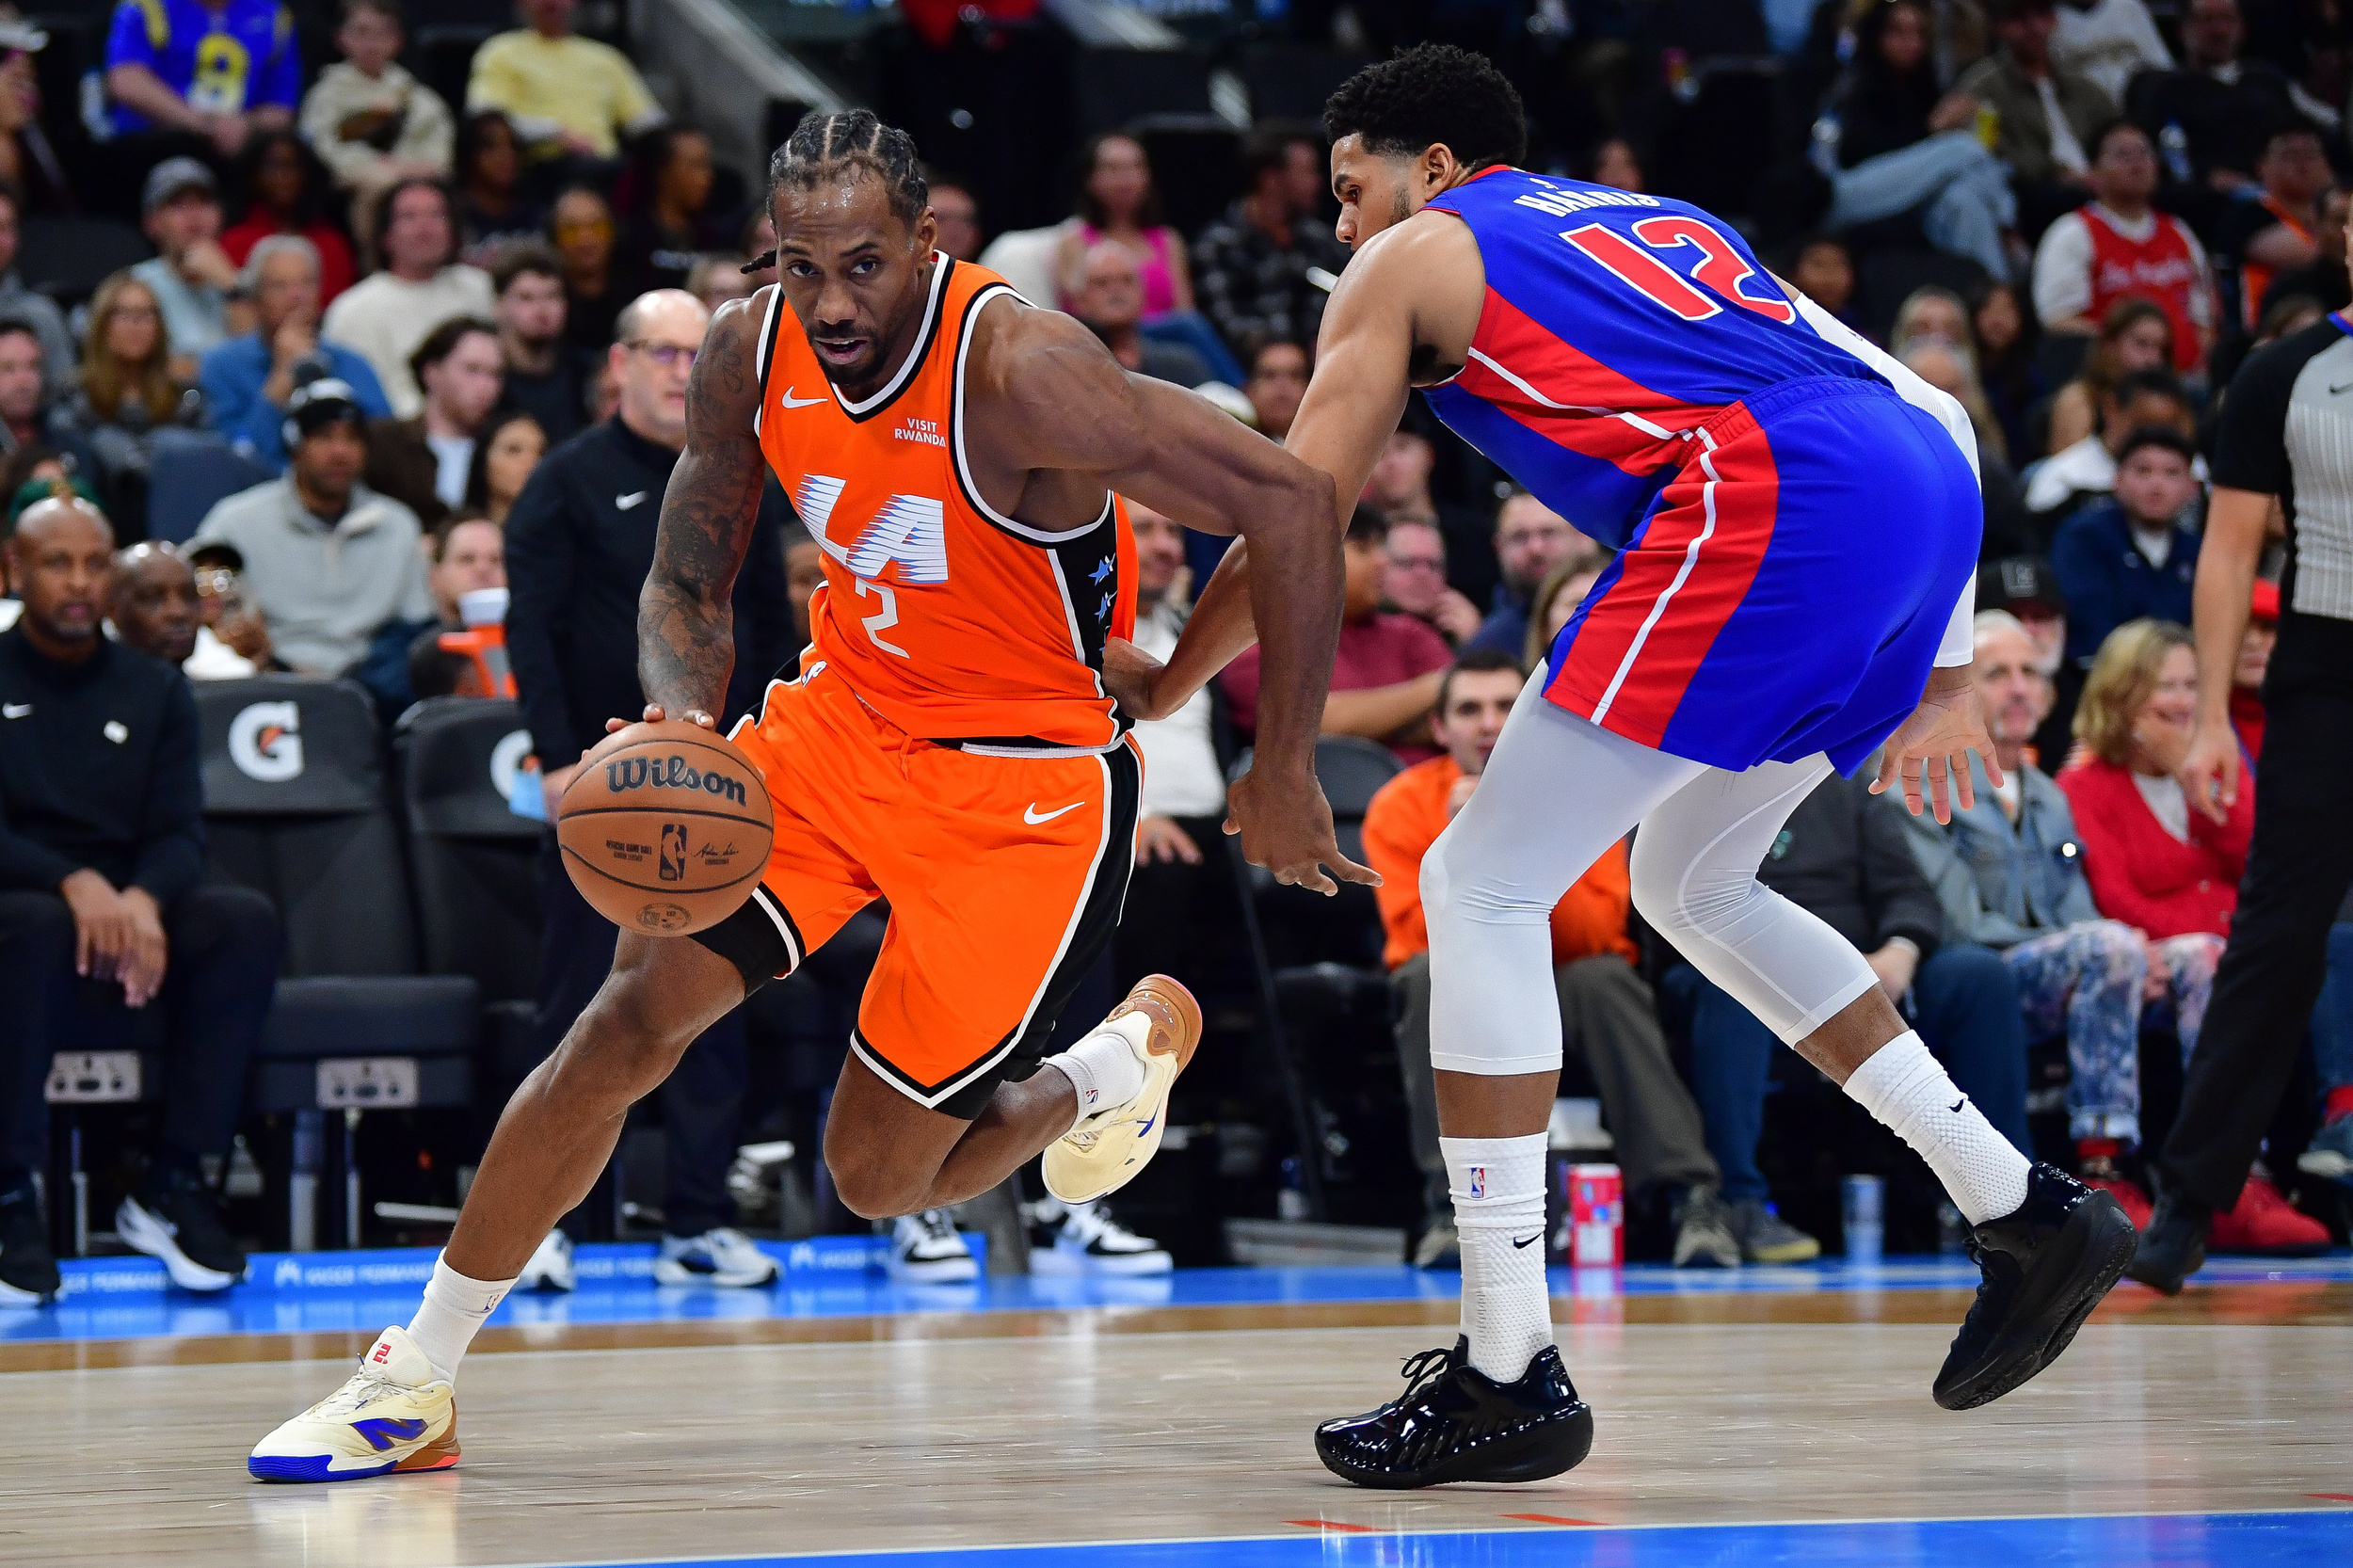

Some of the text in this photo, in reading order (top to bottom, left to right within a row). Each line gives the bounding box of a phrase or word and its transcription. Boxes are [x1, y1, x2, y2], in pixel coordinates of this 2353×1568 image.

[1559, 216, 1796, 326] 12
[894, 427, 947, 448] RWANDA
[906, 417, 937, 433] VISIT
[795, 473, 949, 584] LA
[855, 575, 911, 659] 2
[228, 700, 304, 783] G
[605, 755, 747, 808] Wilson
